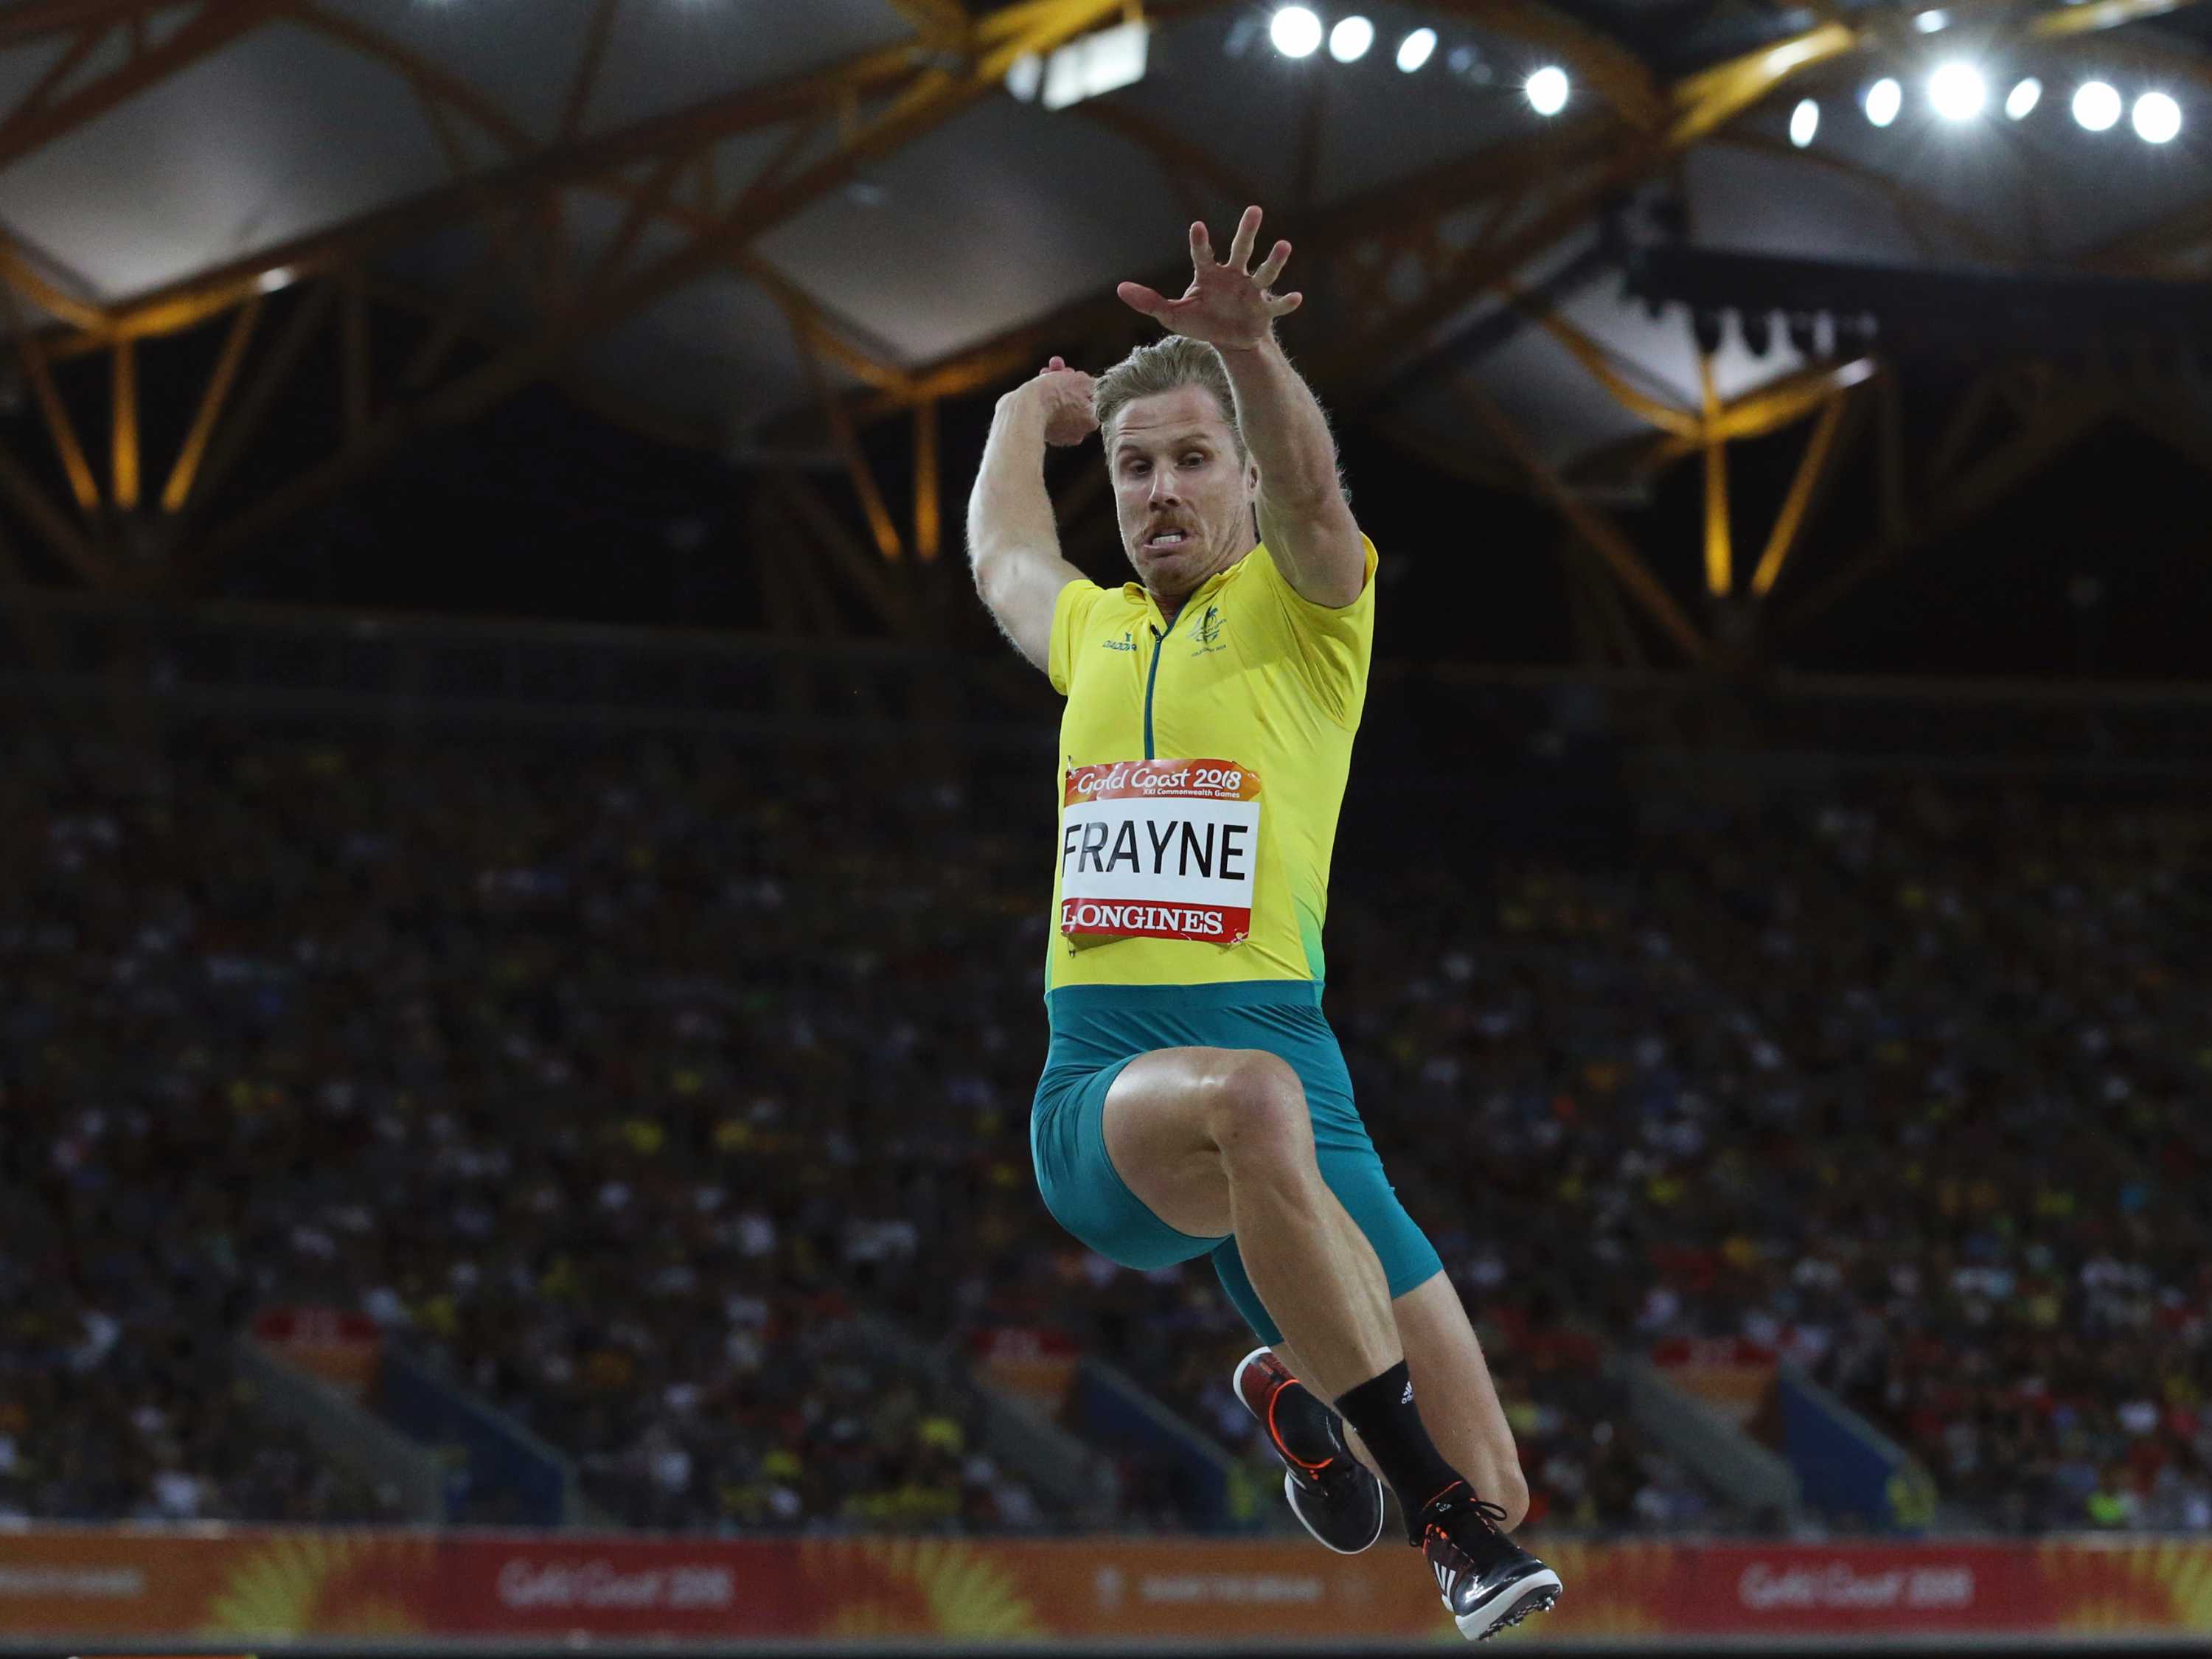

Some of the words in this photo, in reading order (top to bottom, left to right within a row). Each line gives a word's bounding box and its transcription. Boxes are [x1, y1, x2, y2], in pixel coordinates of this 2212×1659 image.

[1077, 769, 1126, 794] Gold
[1130, 768, 1192, 788] Coast
[1193, 768, 1241, 790] 2018
[1157, 788, 1213, 797] Commonwealth
[1214, 790, 1240, 799] Games
[1062, 820, 1249, 880] FRAYNE
[1062, 904, 1223, 934] LONGINES
